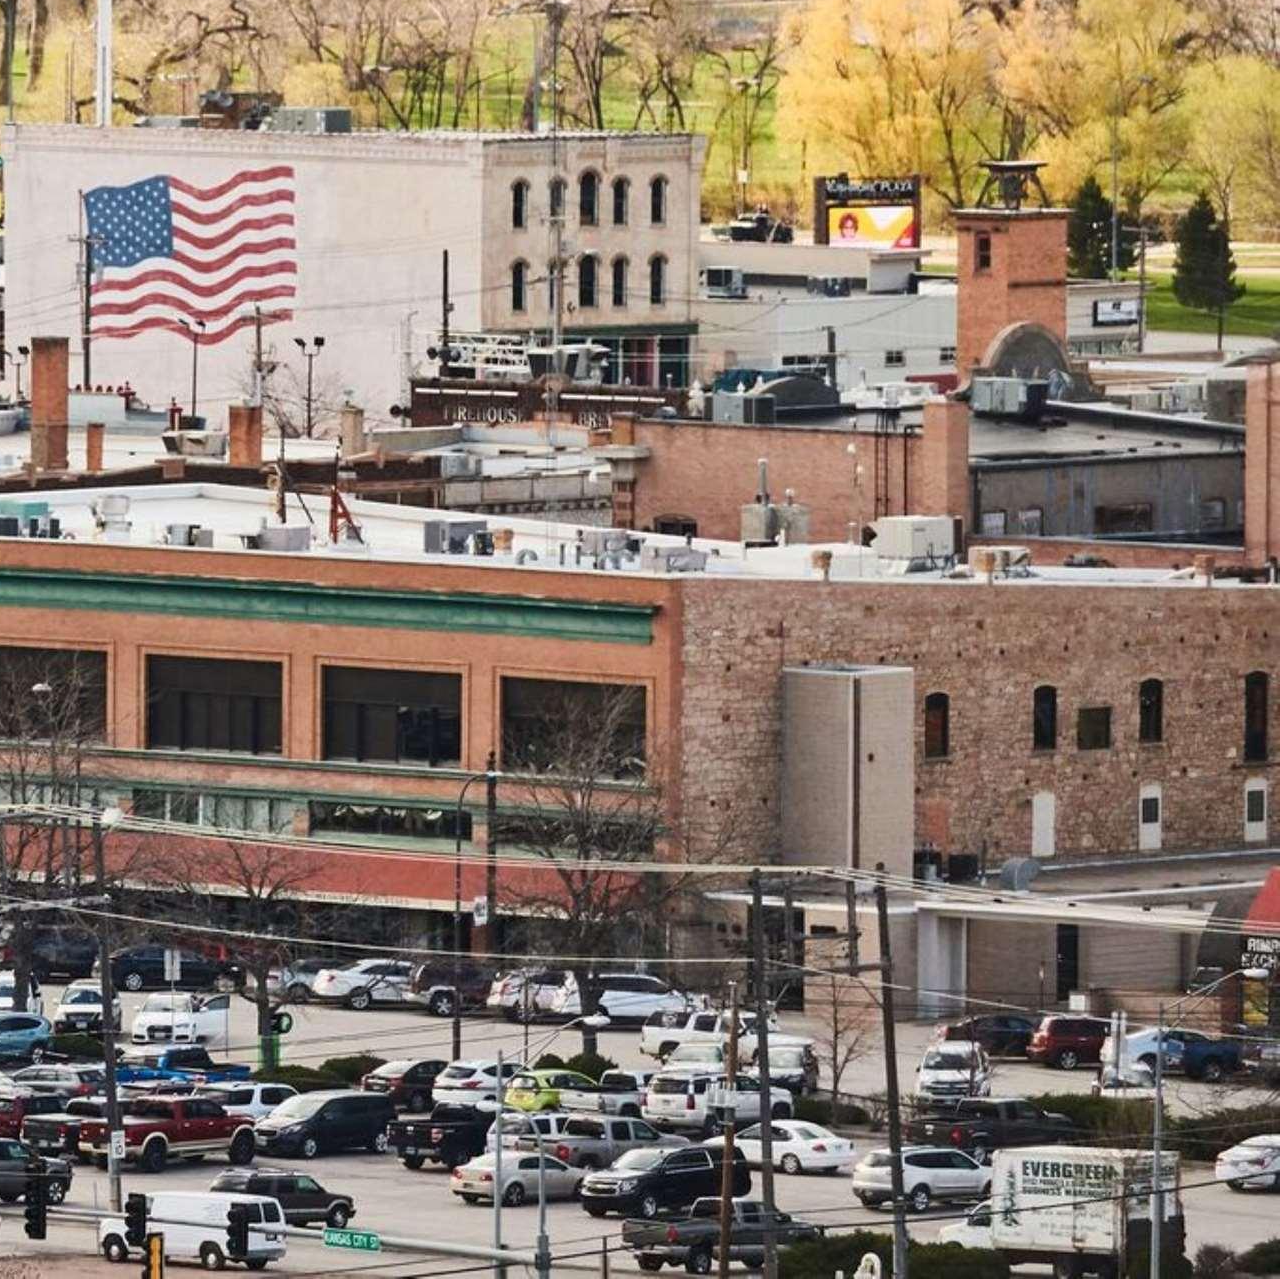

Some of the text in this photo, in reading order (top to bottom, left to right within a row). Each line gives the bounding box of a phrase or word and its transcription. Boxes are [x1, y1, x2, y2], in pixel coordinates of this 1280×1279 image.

[880, 180, 913, 192] PLAZA
[1022, 1160, 1116, 1180] EVERGREEN
[324, 1231, 351, 1246] KANSAS
[353, 1234, 368, 1248] CITY
